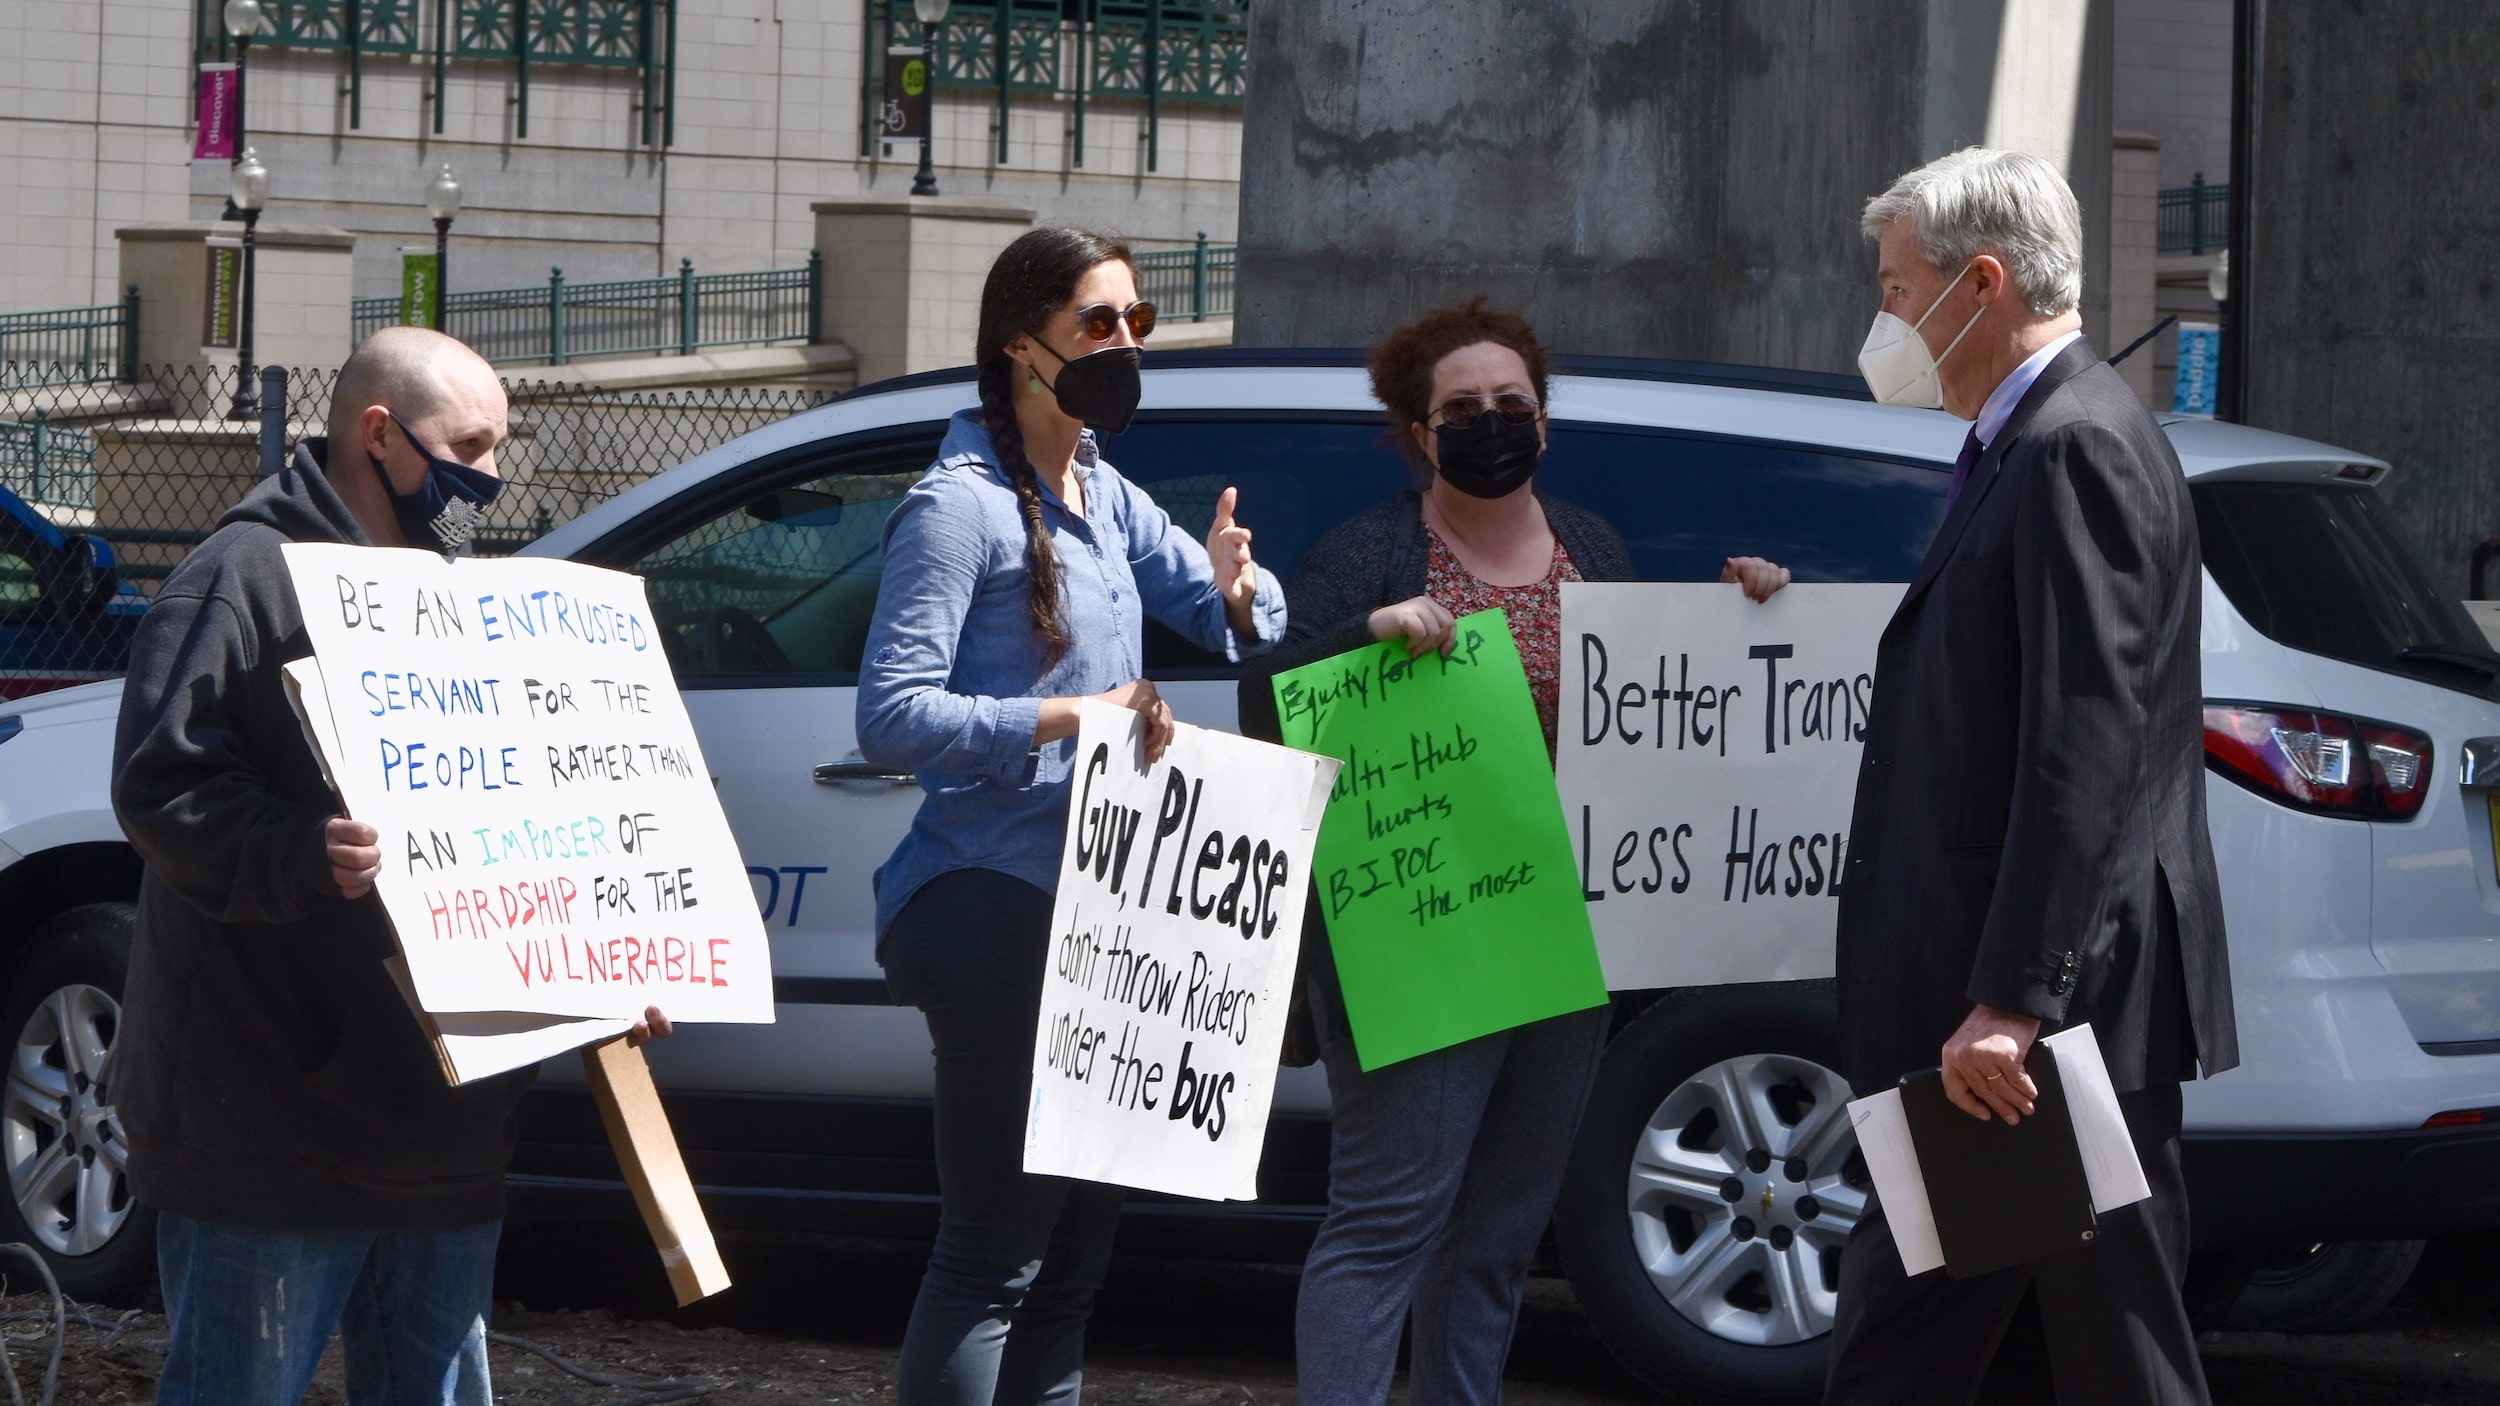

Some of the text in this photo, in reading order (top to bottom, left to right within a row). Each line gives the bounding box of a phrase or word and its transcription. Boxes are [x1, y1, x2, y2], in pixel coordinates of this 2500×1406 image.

[208, 71, 224, 145] discover
[219, 250, 232, 337] GREENWAY
[410, 271, 425, 327] grow
[336, 574, 647, 652] BE AN ENTRUSTED
[361, 670, 651, 718] SERVANT FOR THE
[1281, 672, 1370, 746] Equity
[1377, 648, 1416, 702] for
[1581, 632, 1872, 757] Better Trans
[379, 738, 694, 792] PEOPLE RATHER THAN
[1331, 722, 1478, 804] ulti-Hub
[406, 812, 659, 877] AN IMPOSER OF
[1366, 793, 1453, 841] hurts
[1582, 805, 1693, 902] Less
[423, 867, 699, 941] HARDSHIP FOR THE
[1408, 861, 1537, 927] the most
[506, 933, 731, 990] VULNERABLE
[1058, 904, 1255, 1046] don't throw Riders
[1047, 1012, 1234, 1143] under the bus
